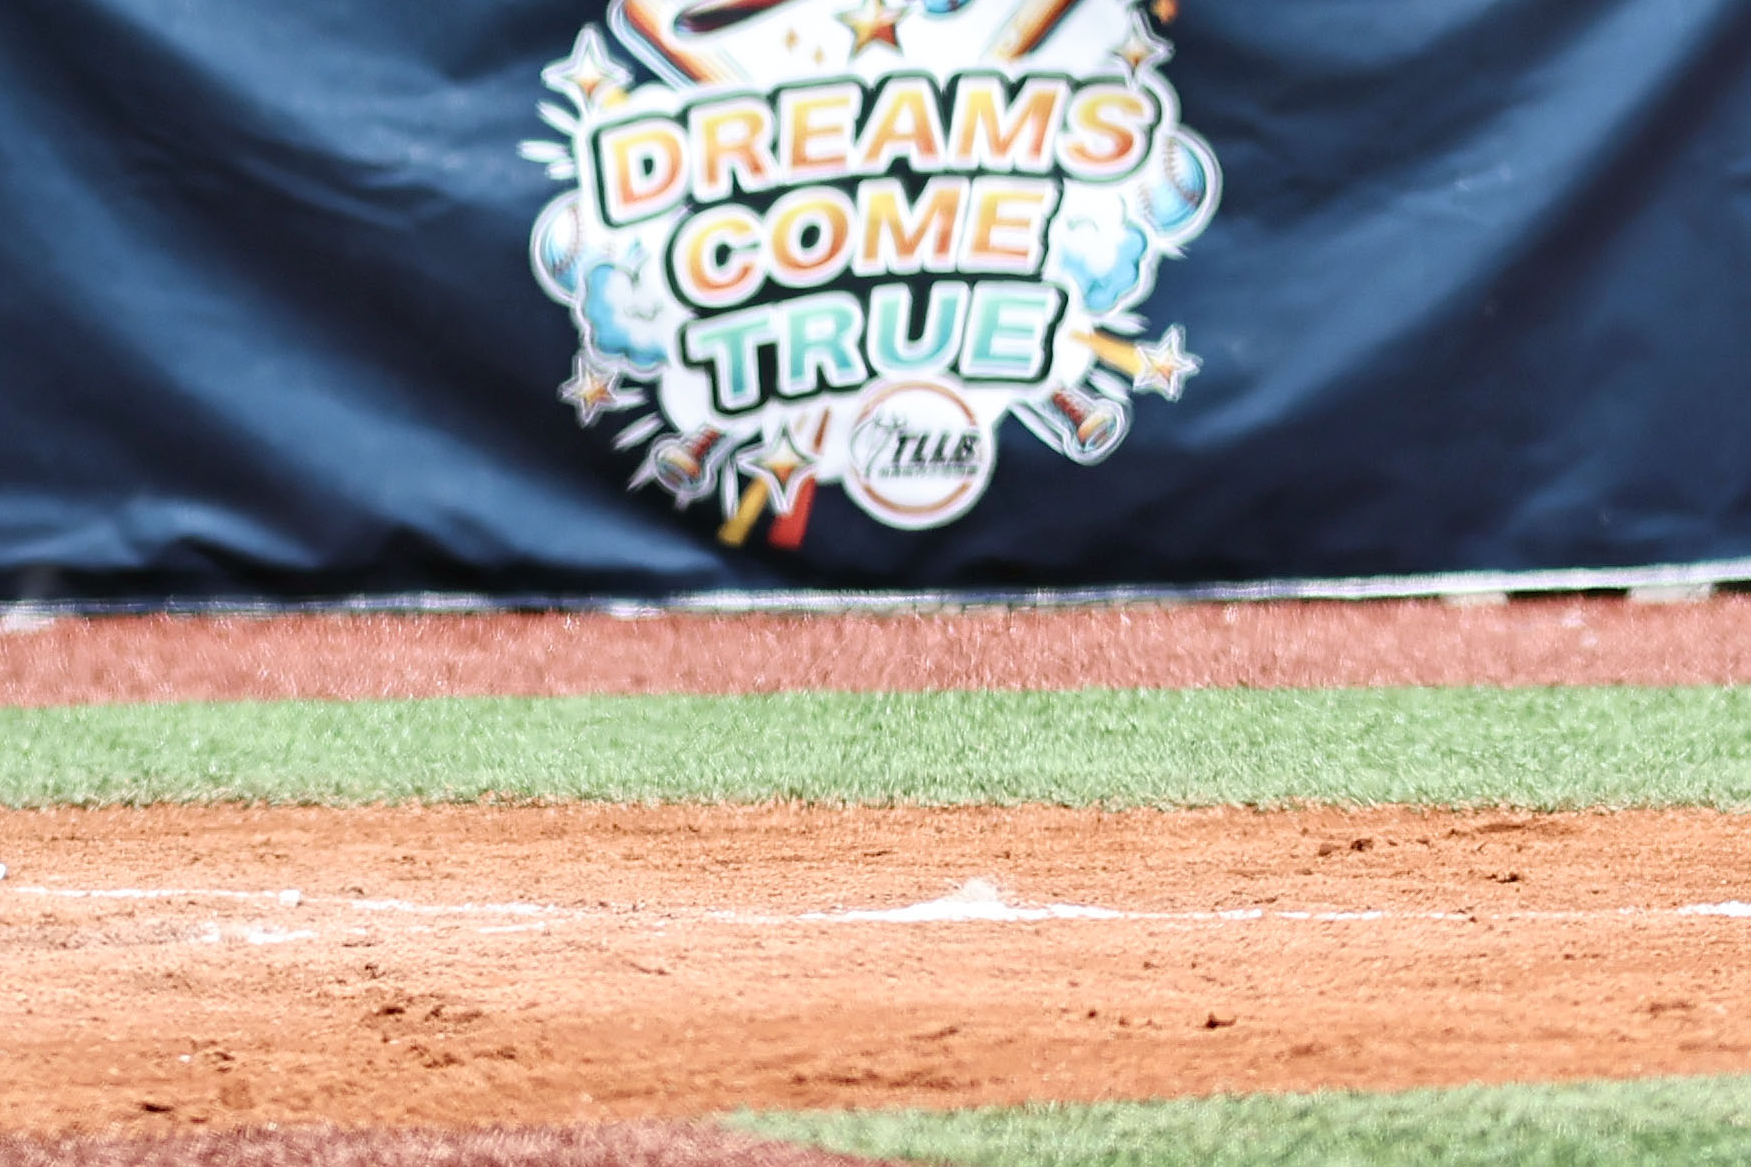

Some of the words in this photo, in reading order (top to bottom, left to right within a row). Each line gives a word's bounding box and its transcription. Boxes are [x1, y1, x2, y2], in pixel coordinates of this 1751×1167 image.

[602, 80, 1152, 218] DREAMS
[681, 183, 1049, 300] COME
[694, 286, 1053, 403] TRUE
